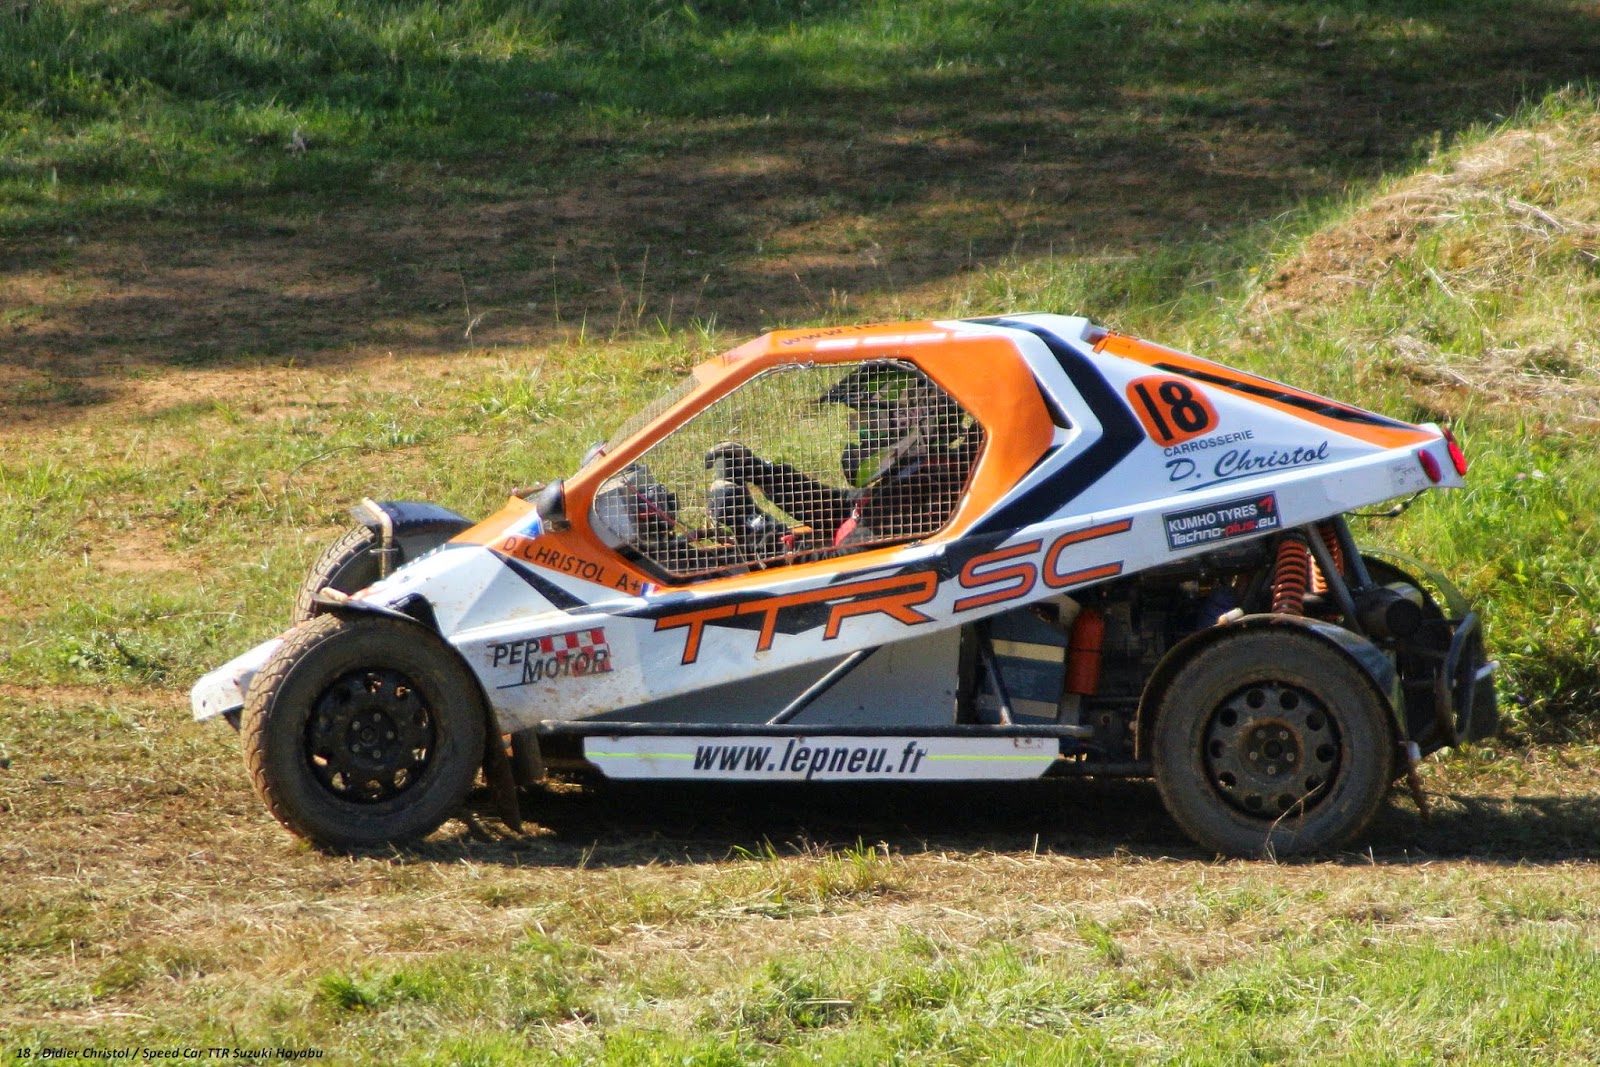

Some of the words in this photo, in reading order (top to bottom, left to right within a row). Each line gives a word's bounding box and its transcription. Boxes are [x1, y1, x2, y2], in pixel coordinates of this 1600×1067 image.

[1134, 381, 1209, 442] 18
[1163, 430, 1255, 458] CARROSSERIE
[1165, 457, 1201, 482] D.
[1213, 441, 1330, 478] Christol
[1168, 512, 1217, 533] KUMHO
[1217, 503, 1258, 522] TYRES
[523, 544, 610, 584] CHRISTOL
[615, 572, 641, 592] A+
[487, 640, 541, 668] PEP
[521, 649, 611, 685] MOTOR
[693, 738, 928, 781] www.lepneu.fr
